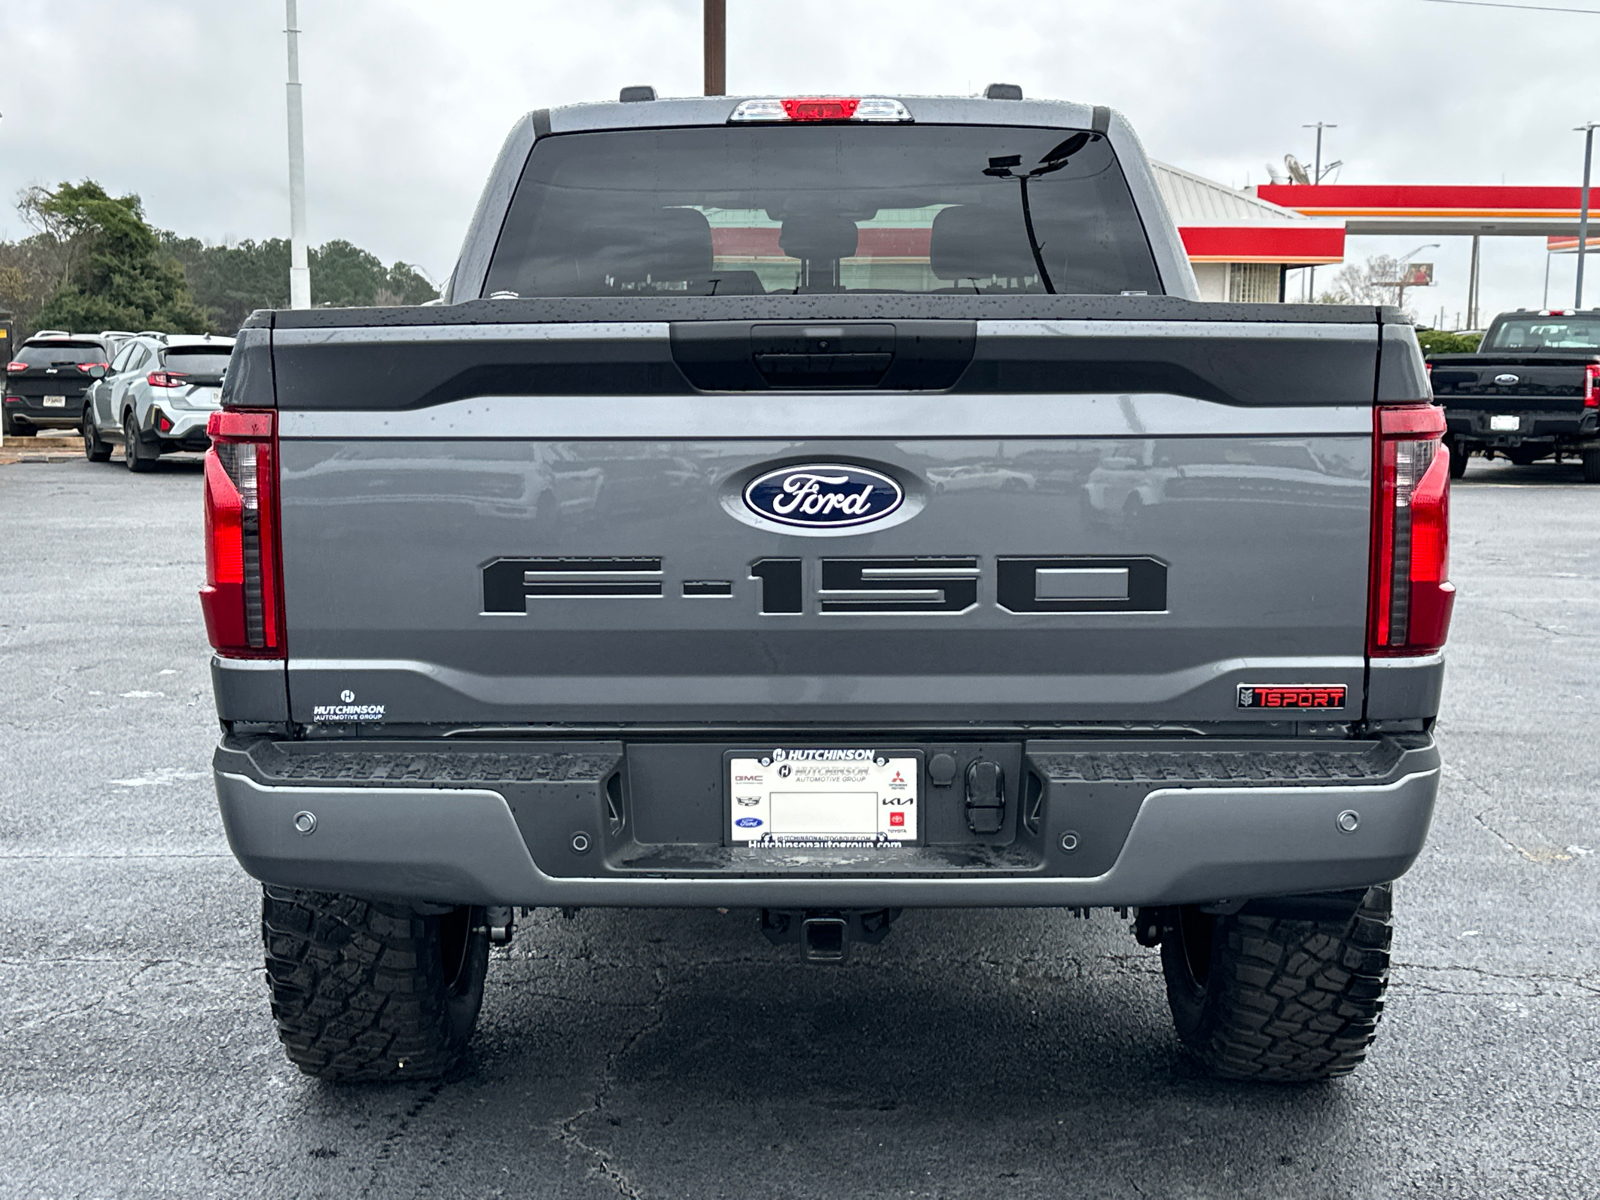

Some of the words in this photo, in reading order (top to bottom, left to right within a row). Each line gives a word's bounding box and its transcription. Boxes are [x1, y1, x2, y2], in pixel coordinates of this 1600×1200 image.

[773, 473, 874, 515] Ford
[480, 556, 1170, 616] F-150
[314, 705, 386, 715] HUTCHINSON
[788, 749, 876, 761] HUTCHINSON
[740, 818, 759, 827] Ford
[748, 839, 903, 848] Hutchinsonautogroupcom
